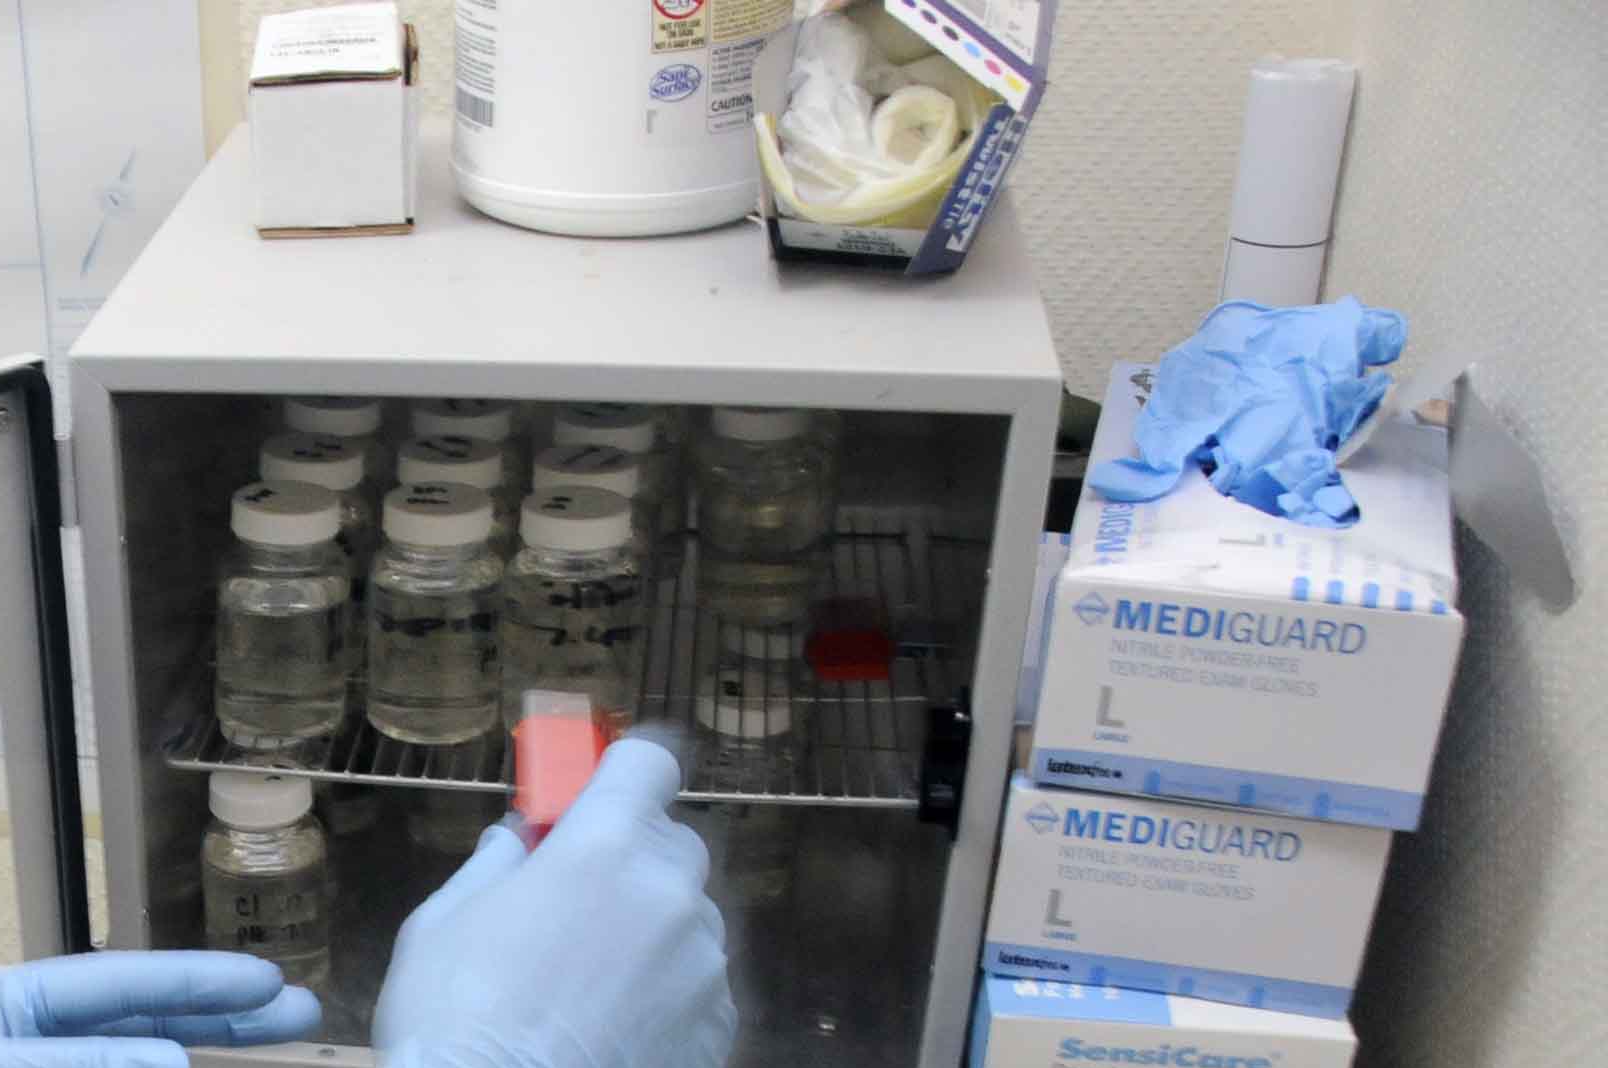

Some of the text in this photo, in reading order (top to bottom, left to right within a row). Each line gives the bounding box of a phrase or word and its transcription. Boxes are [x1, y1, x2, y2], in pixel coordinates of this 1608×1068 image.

[1112, 599, 1367, 655] MEDIGUARD
[1095, 685, 1125, 728] L
[1063, 807, 1302, 862] MEDIGUARD
[1045, 889, 1073, 928] L
